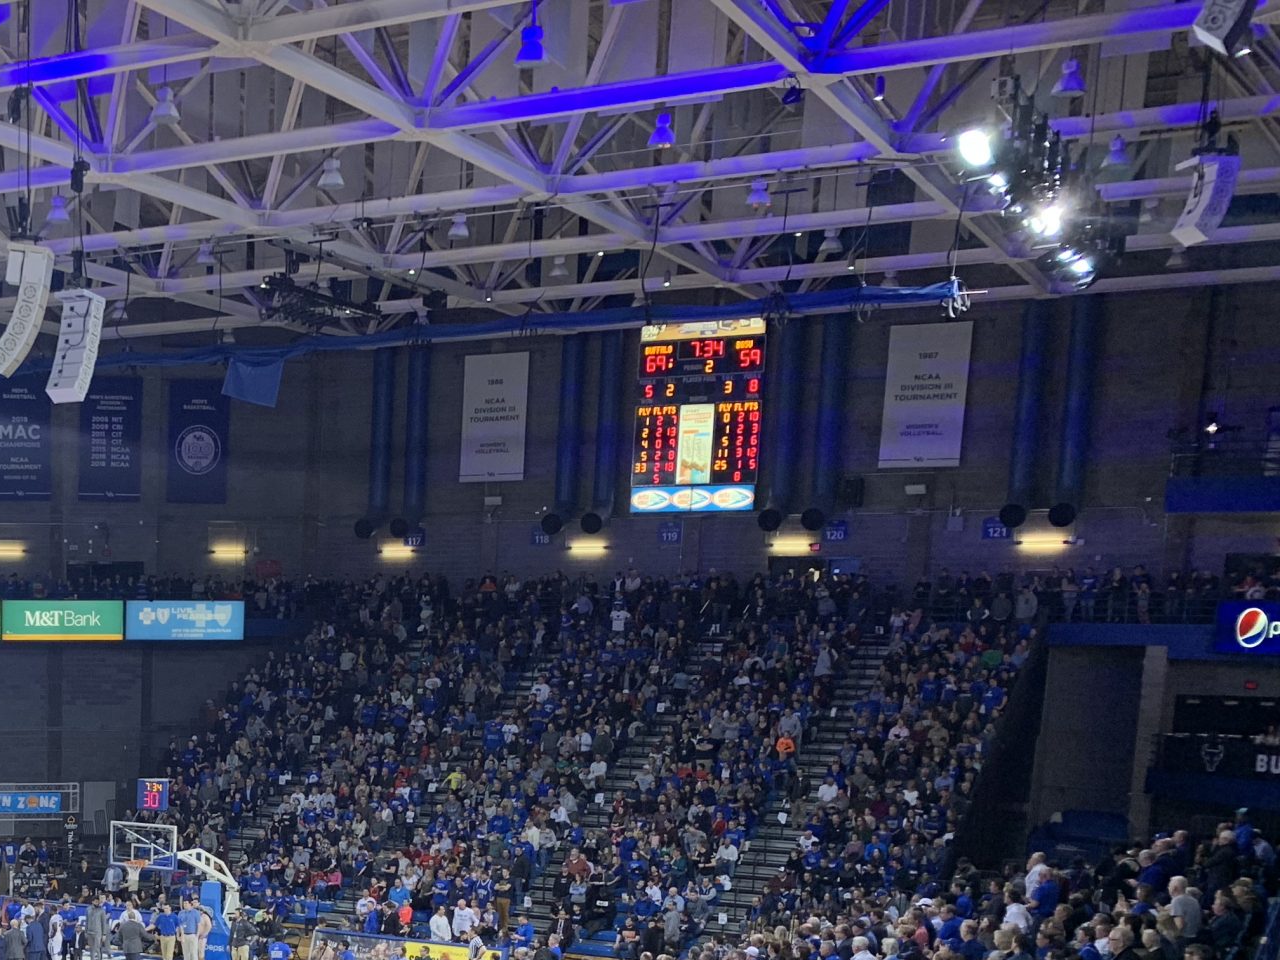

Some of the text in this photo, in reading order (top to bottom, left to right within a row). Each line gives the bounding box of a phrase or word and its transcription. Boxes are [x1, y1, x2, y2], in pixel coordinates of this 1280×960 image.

[691, 340, 724, 358] 7:34
[740, 349, 760, 367] 59
[646, 356, 666, 372] 69
[705, 360, 714, 372] 2
[914, 373, 941, 381] NCAA
[666, 384, 674, 397] 2
[724, 381, 733, 394] 3
[749, 379, 759, 392] 8
[900, 383, 941, 392] DIVISION
[645, 385, 653, 398] 5
[894, 392, 959, 402] TOURNAMENT
[663, 406, 676, 415] PTS
[744, 402, 759, 411] PTS
[470, 414, 519, 423] TOURNAMENT
[662, 531, 678, 542] 119
[826, 530, 844, 540] 120
[988, 527, 1007, 538] 121
[407, 537, 422, 546] 117
[534, 535, 550, 545] 118
[24, 610, 101, 627] M&T Bank
[145, 782, 163, 791] 7:34
[144, 792, 159, 808] 30
